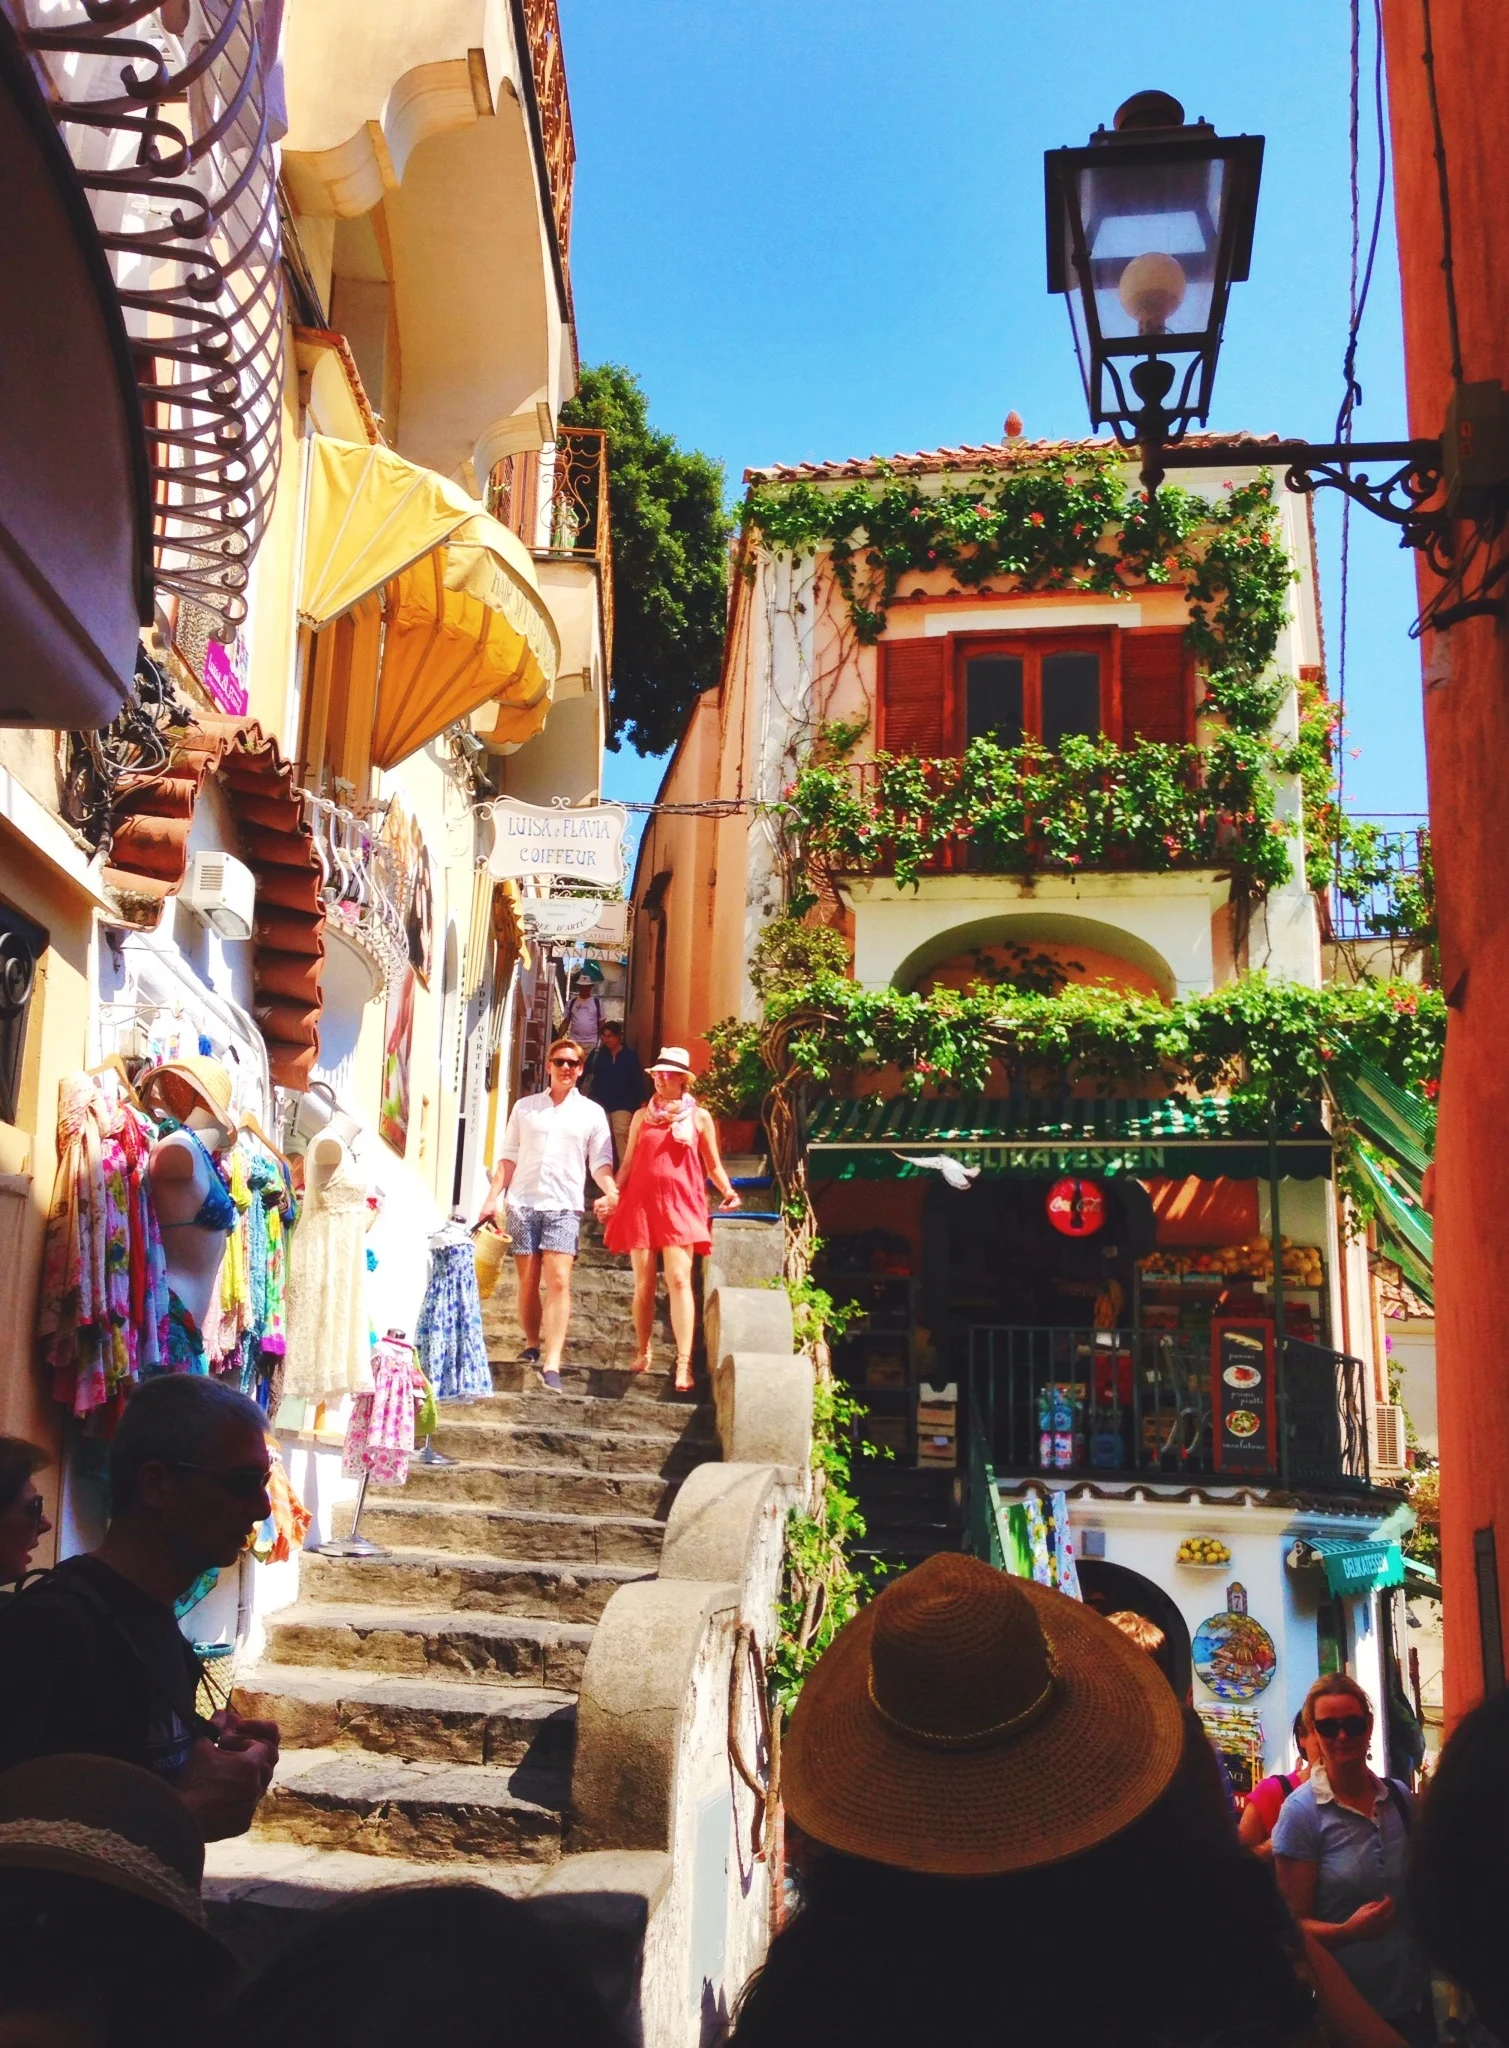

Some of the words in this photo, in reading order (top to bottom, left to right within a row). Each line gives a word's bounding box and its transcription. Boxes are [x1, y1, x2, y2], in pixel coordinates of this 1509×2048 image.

[508, 817, 551, 836] LUISA
[563, 819, 610, 838] FLAVIA
[519, 847, 597, 865] COIFFEUR
[554, 945, 621, 961] SANDALS
[943, 1147, 1166, 1169] DELIKATESSEN
[1229, 1353, 1255, 1361] panini
[1342, 1553, 1389, 1579] DELIKATESSEN
[1233, 1595, 1241, 1609] 7
